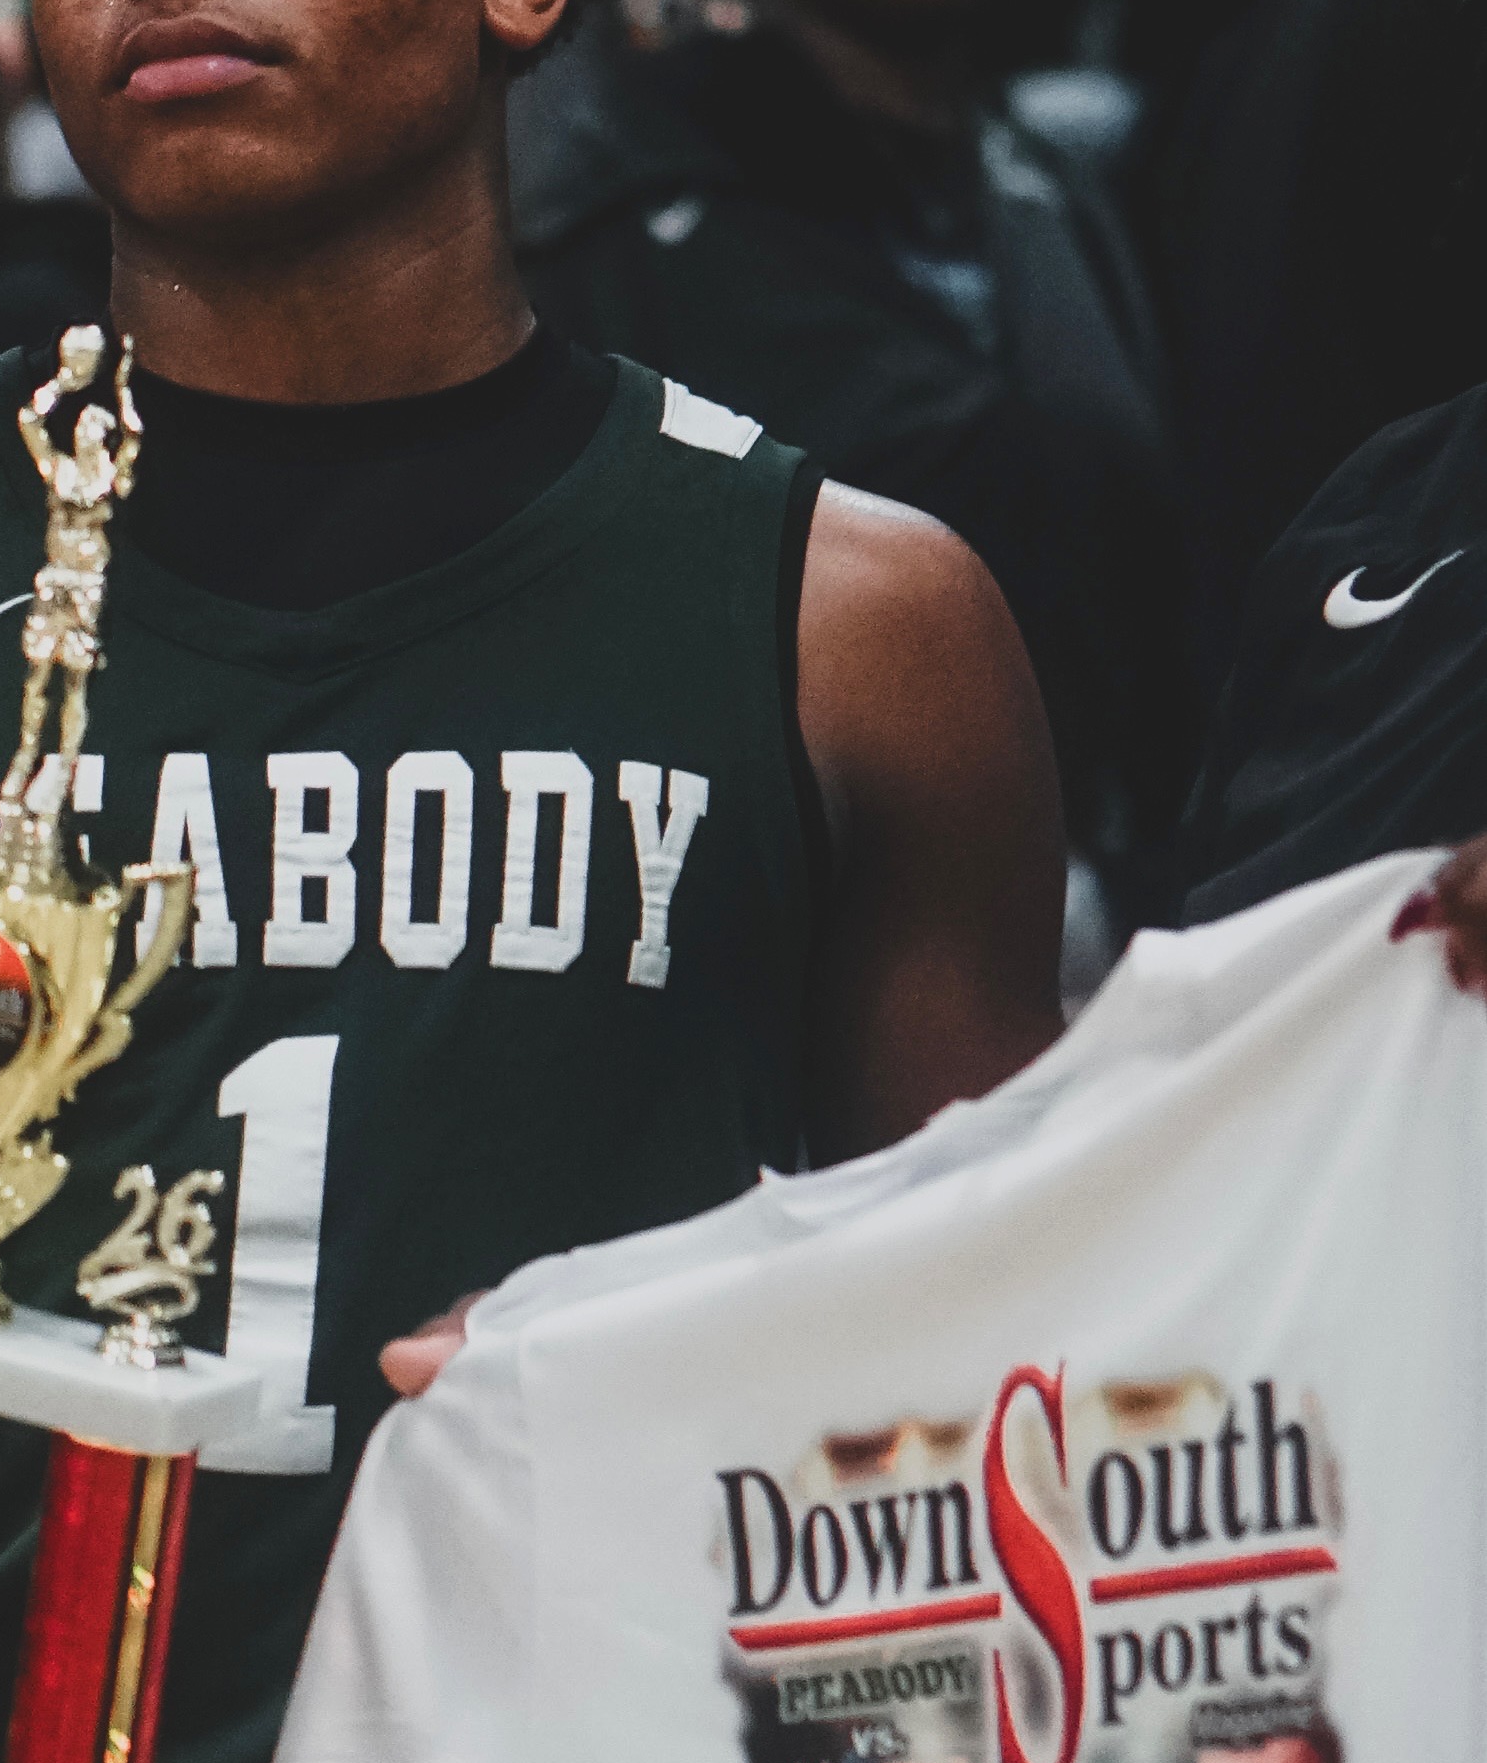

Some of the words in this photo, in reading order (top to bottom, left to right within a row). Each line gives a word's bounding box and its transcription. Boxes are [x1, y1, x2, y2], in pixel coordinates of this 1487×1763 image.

[79, 1163, 226, 1273] 26
[197, 1035, 340, 1475] 1
[716, 1467, 979, 1617] Down
[780, 1654, 969, 1719] PEABODY
